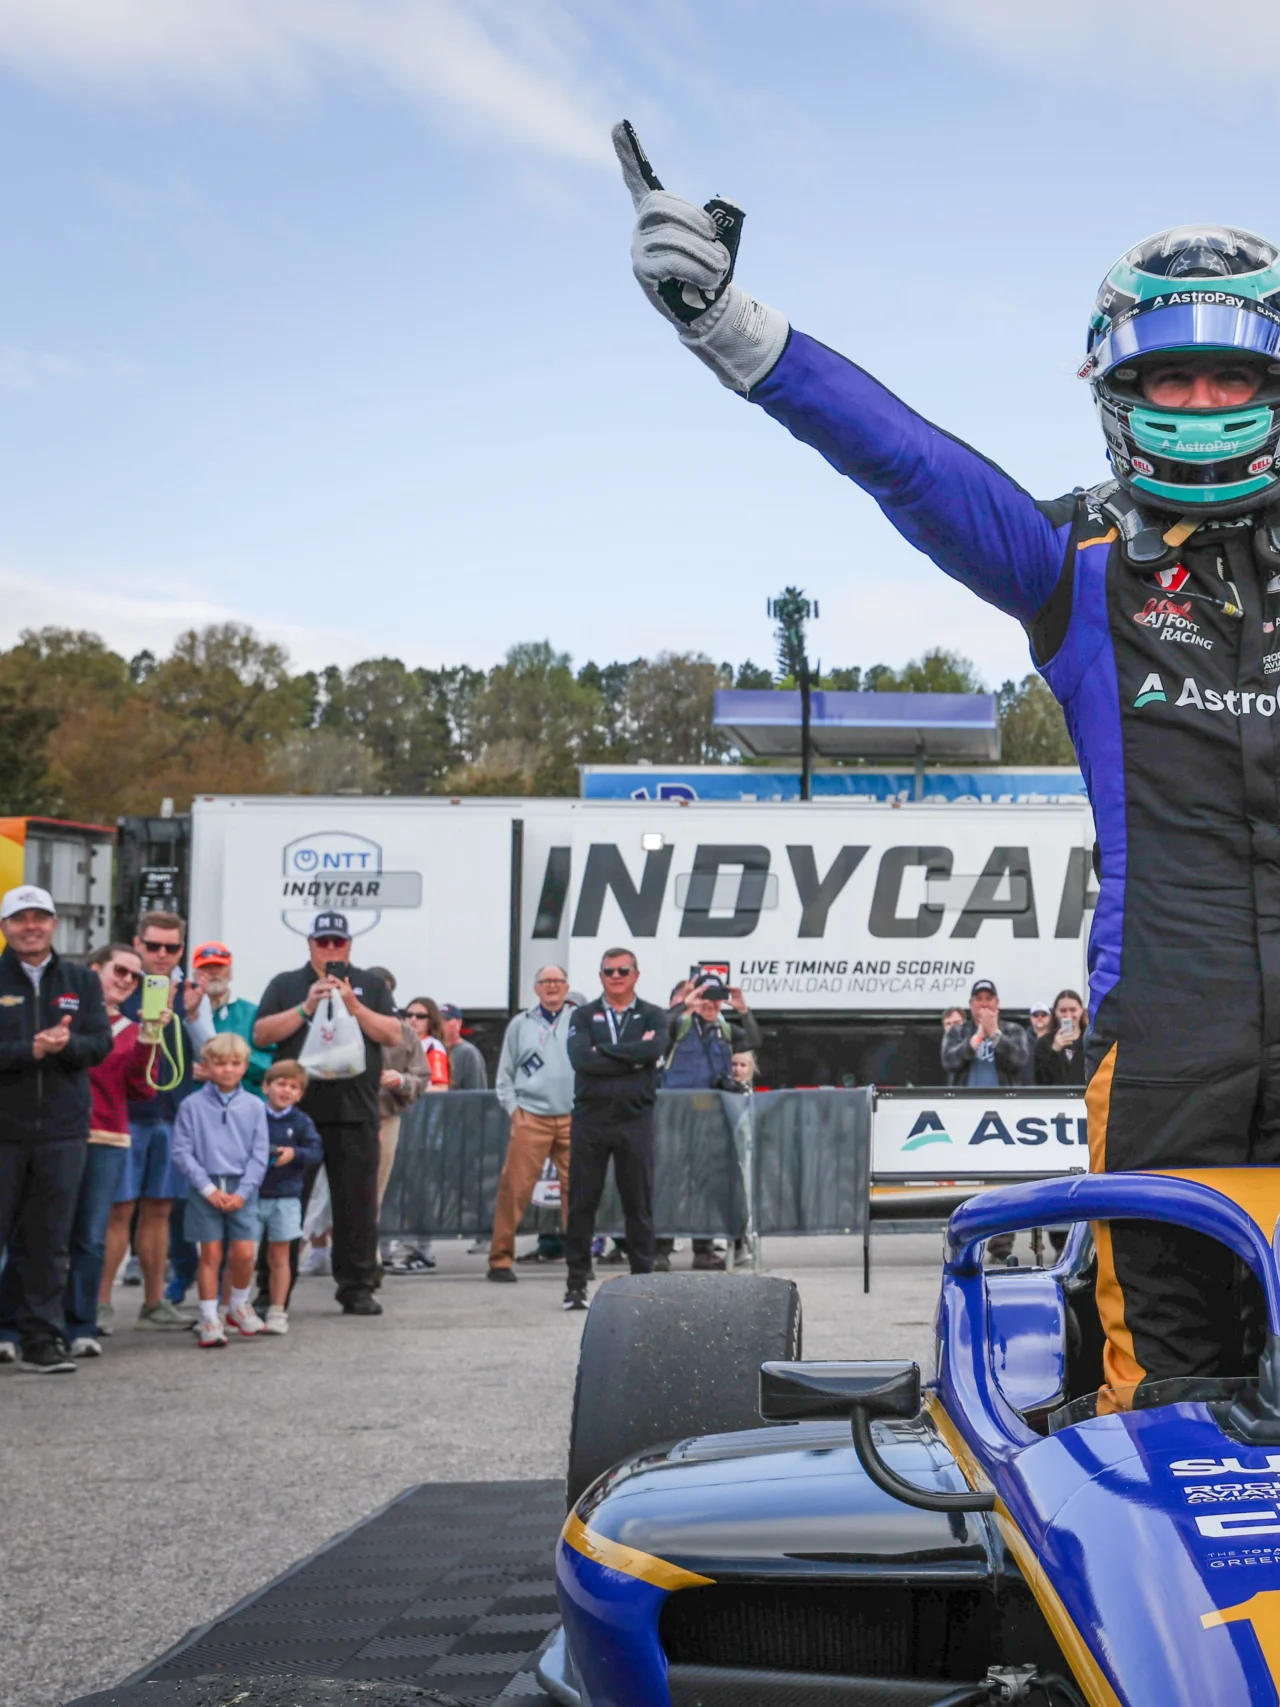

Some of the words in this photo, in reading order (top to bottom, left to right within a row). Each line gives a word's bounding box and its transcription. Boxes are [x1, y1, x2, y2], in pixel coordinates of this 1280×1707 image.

[1168, 292, 1244, 308] AstroPay
[1176, 440, 1240, 453] AstroPay
[1134, 459, 1151, 473] BELL
[1252, 459, 1271, 472] BELL
[1143, 611, 1165, 628] AJ
[1165, 613, 1200, 632] FOYT
[1160, 627, 1214, 650] RACING
[323, 853, 370, 868] NTT
[283, 881, 381, 897] INDYCAR
[740, 961, 780, 974] LIVE
[786, 961, 848, 974] TIMING
[852, 961, 891, 974] AND
[896, 961, 976, 974] SCORING
[740, 978, 843, 993] DOWNLOAD
[847, 978, 926, 993] INDYCAR
[929, 978, 967, 993] APP
